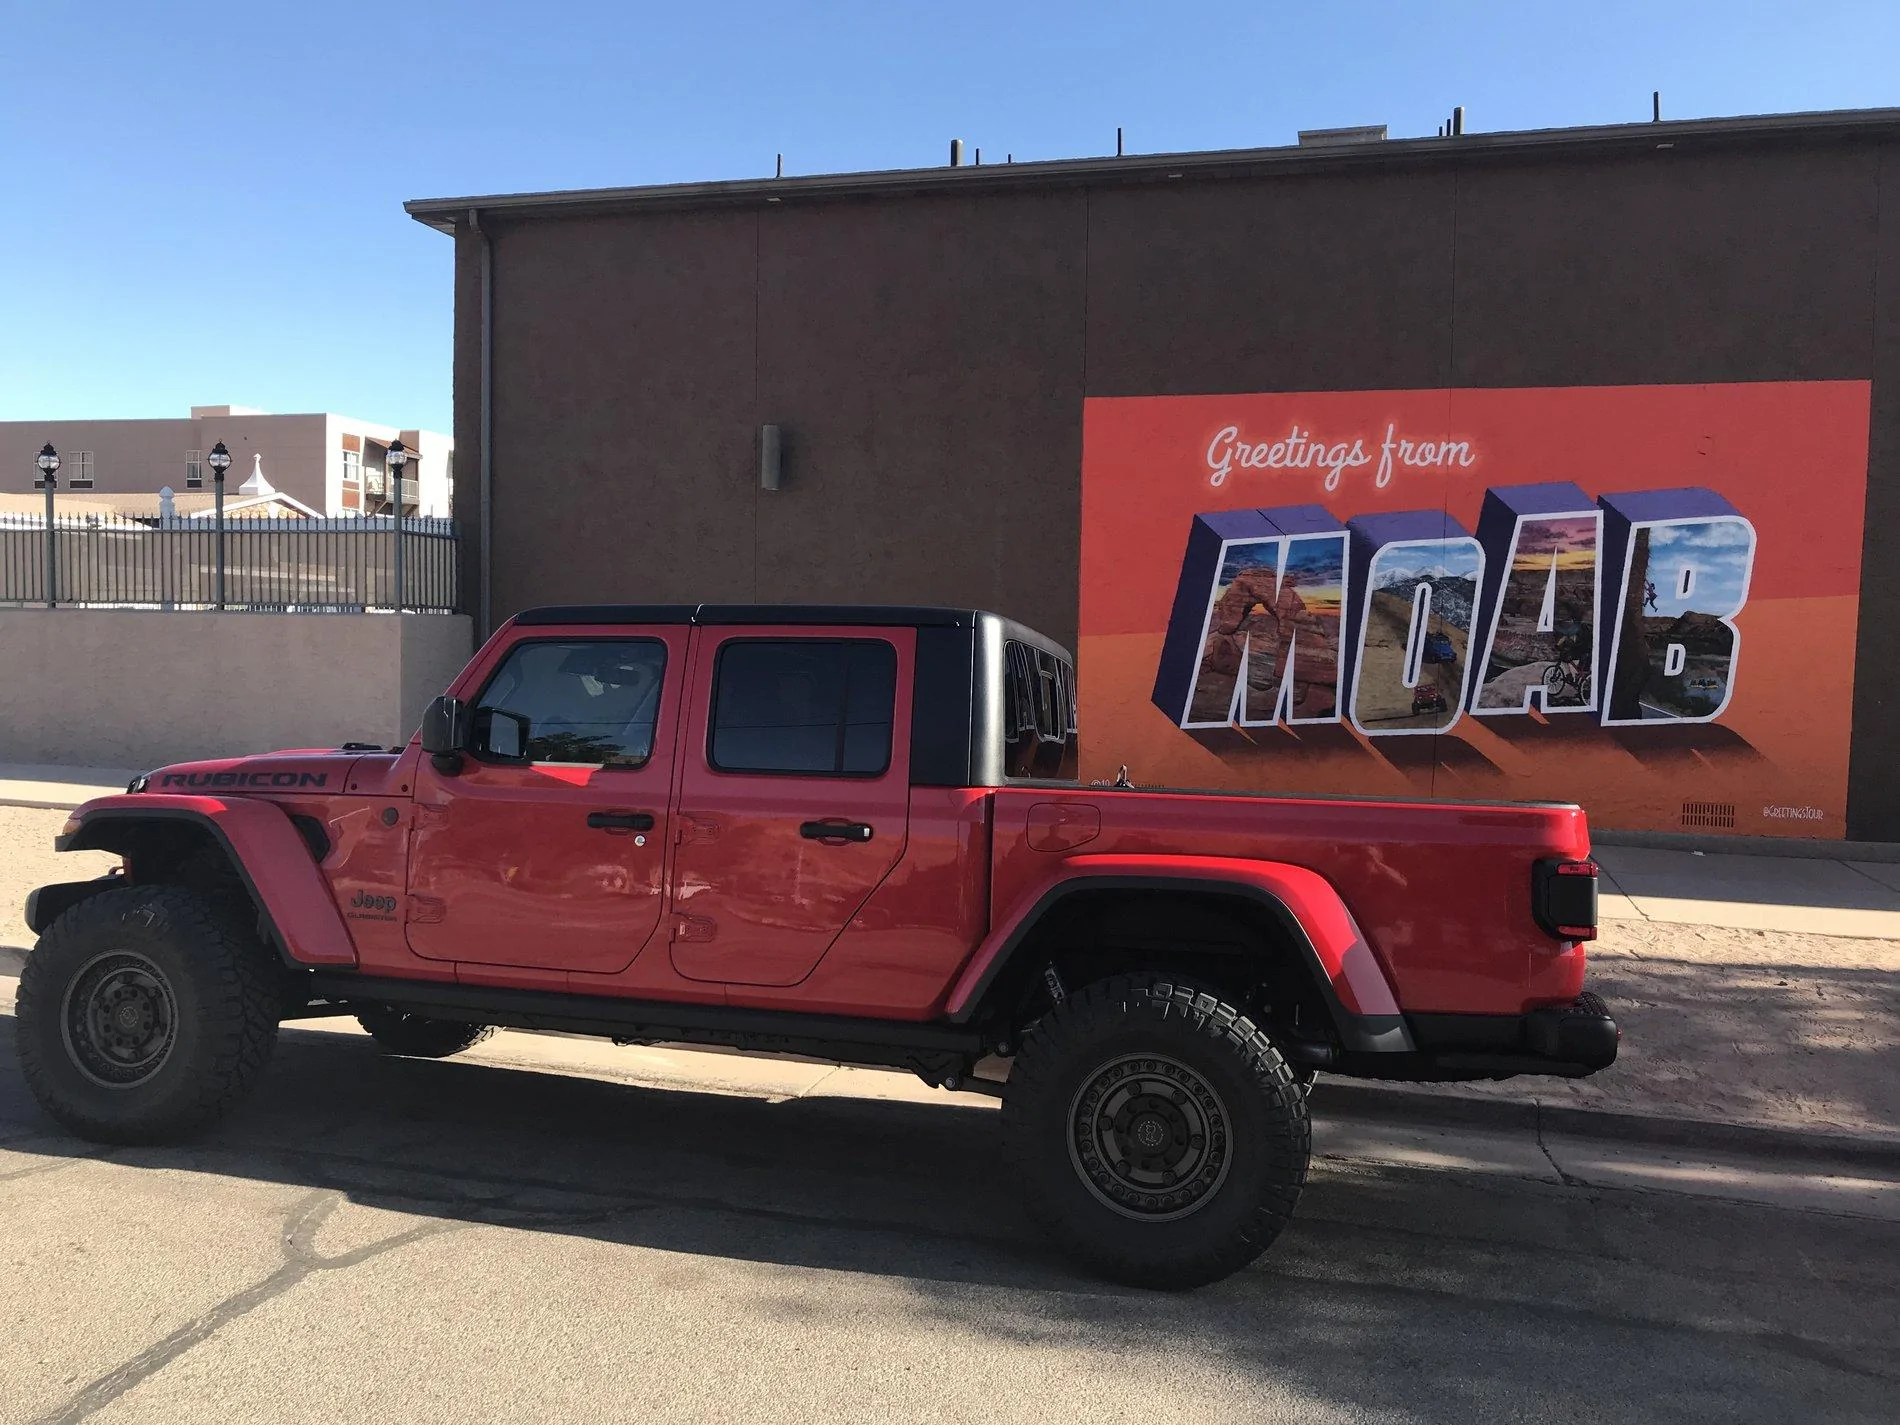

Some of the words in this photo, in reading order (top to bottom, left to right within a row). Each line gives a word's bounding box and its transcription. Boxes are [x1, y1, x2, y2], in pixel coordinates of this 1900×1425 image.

[1207, 426, 1371, 491] Greetings
[1375, 423, 1475, 488] from
[1178, 508, 1758, 736] MOAB
[161, 772, 328, 788] RUBICON
[350, 888, 396, 913] Jeep
